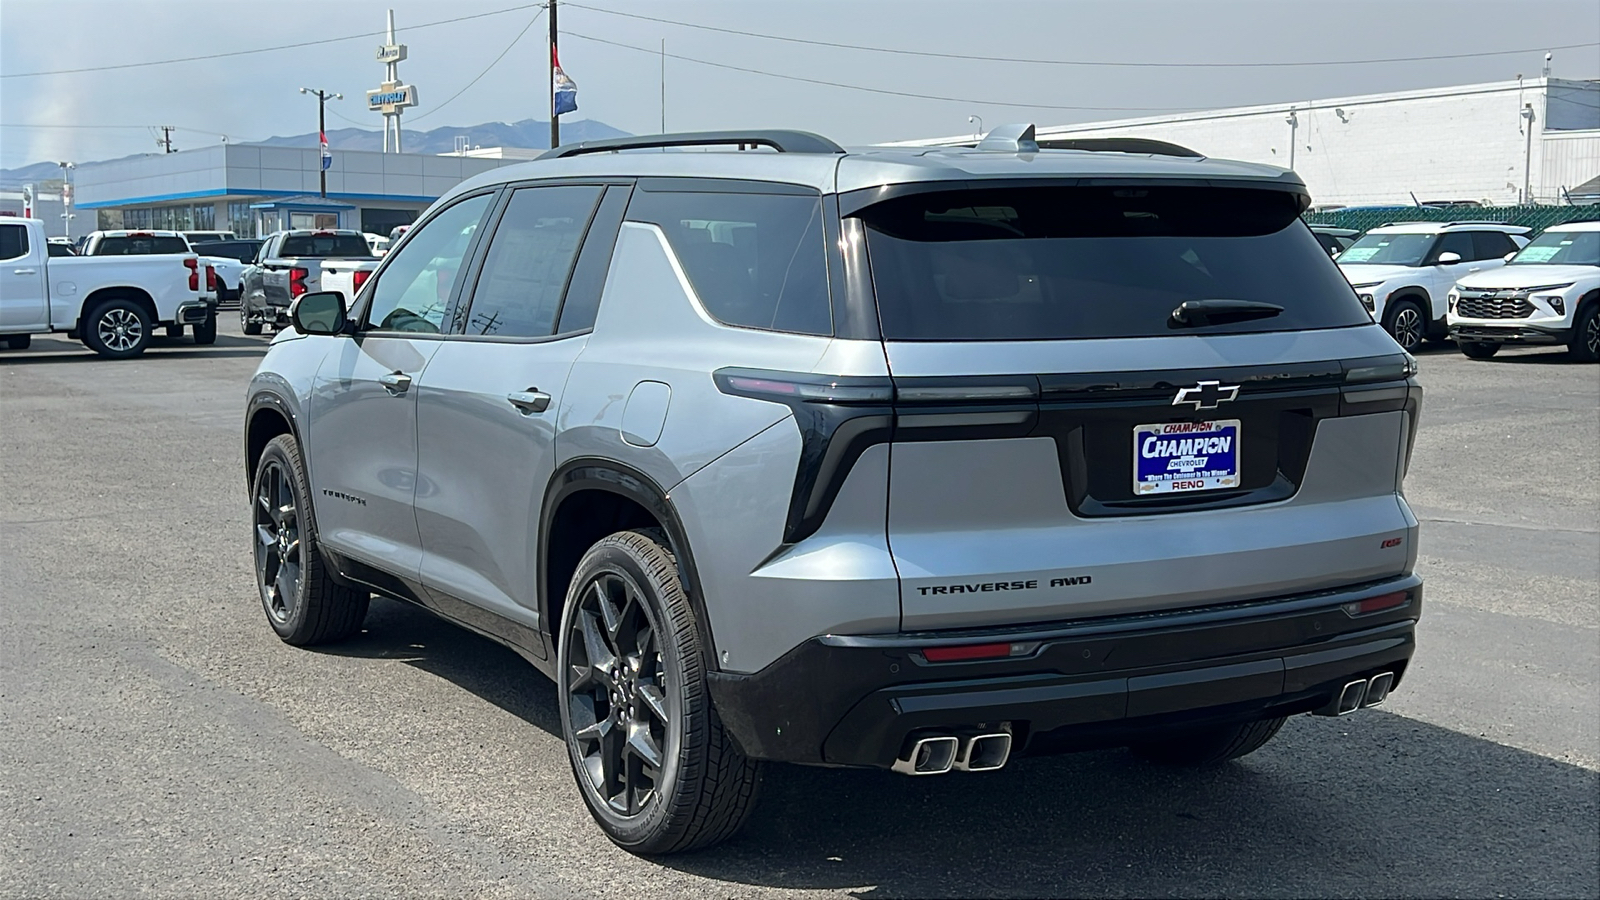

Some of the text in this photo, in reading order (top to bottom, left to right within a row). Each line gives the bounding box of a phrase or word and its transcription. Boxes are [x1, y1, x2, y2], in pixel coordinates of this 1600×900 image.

[1163, 422, 1213, 434] CHAMPION
[1142, 436, 1231, 458] CHAMPION
[1169, 459, 1205, 468] CHEVROLET
[1172, 480, 1204, 490] RENO
[1380, 537, 1403, 549] RS
[917, 576, 1092, 595] TRAVERSE AWD
